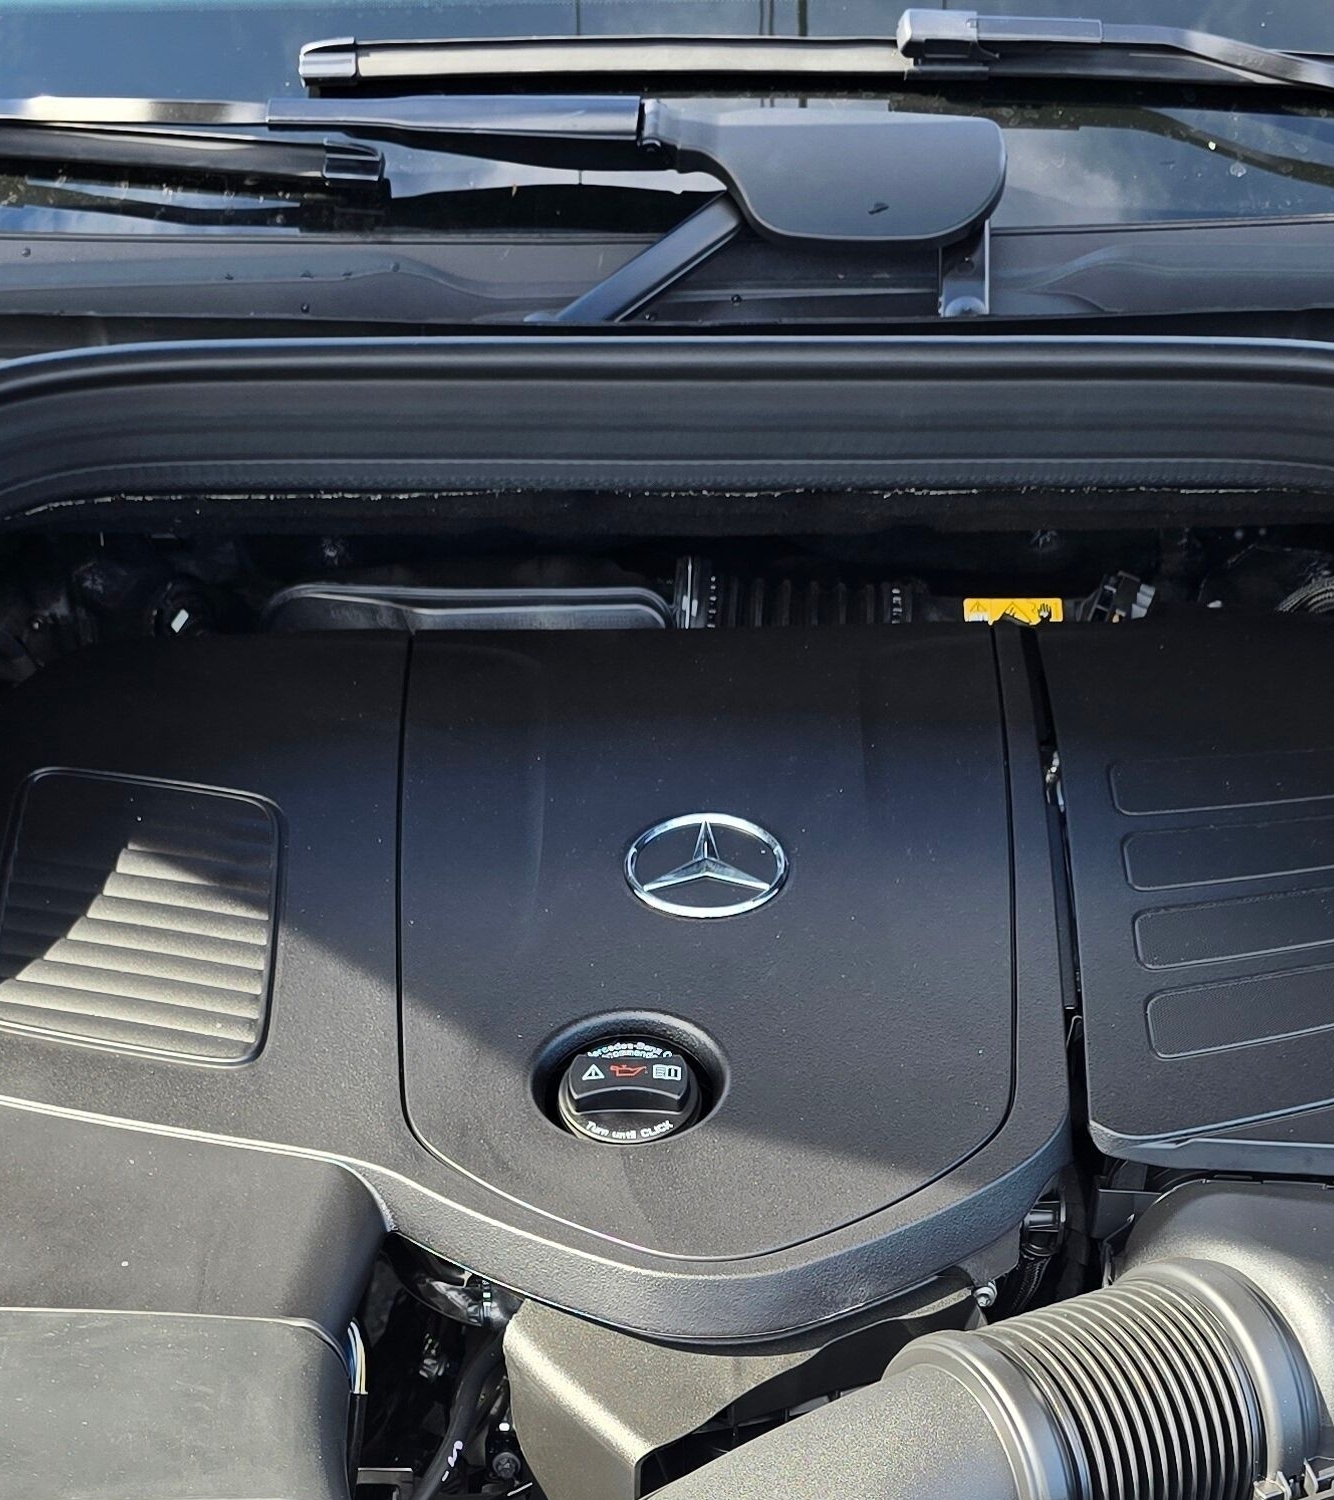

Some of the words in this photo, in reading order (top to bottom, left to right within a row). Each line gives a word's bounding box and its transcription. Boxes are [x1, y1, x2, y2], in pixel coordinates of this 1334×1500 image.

[586, 1120, 610, 1137] Turn
[612, 1129, 637, 1139] until
[640, 1119, 674, 1137] CLICK
